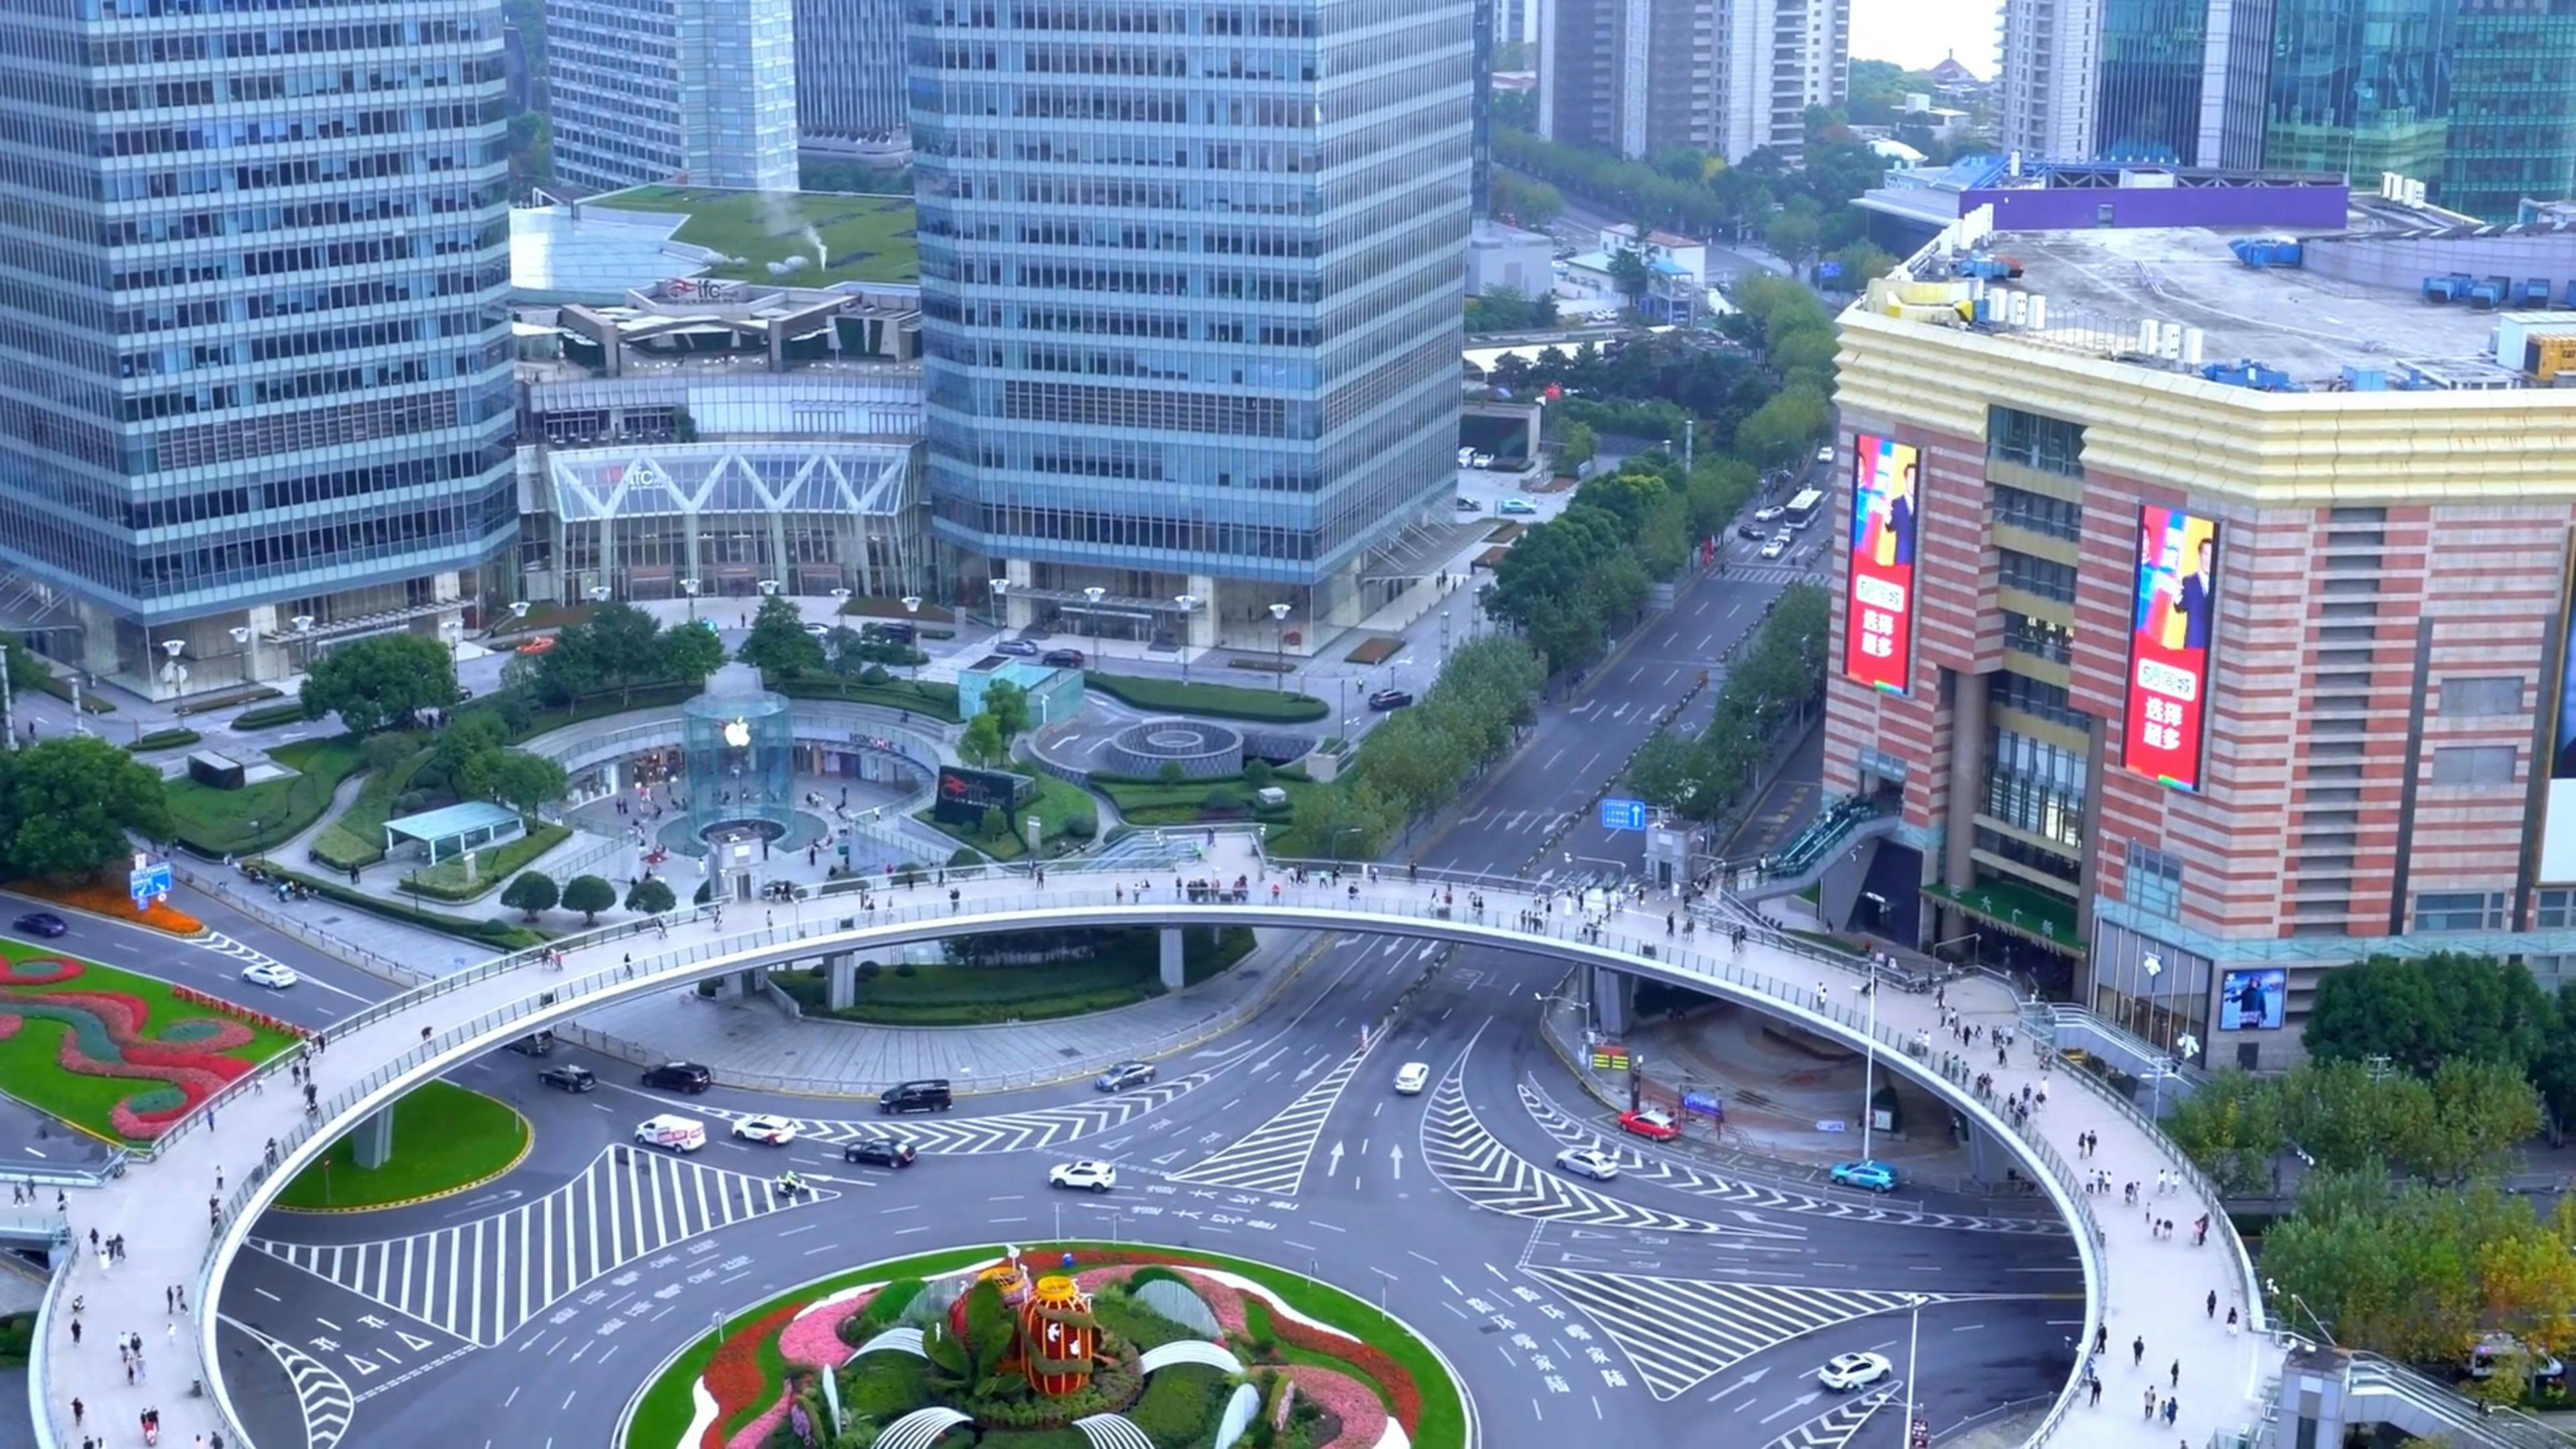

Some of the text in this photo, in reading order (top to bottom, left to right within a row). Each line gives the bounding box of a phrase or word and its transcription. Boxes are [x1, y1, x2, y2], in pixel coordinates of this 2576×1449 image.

[698, 280, 721, 299] ifc
[1863, 608, 1894, 637] 选择
[1862, 631, 1892, 657] 超多
[2145, 696, 2183, 728] 选择
[2143, 721, 2181, 750] 超多
[1465, 1297, 1570, 1393] 陆家嘴环路
[1511, 1285, 1628, 1388] 陆家嘴环路
